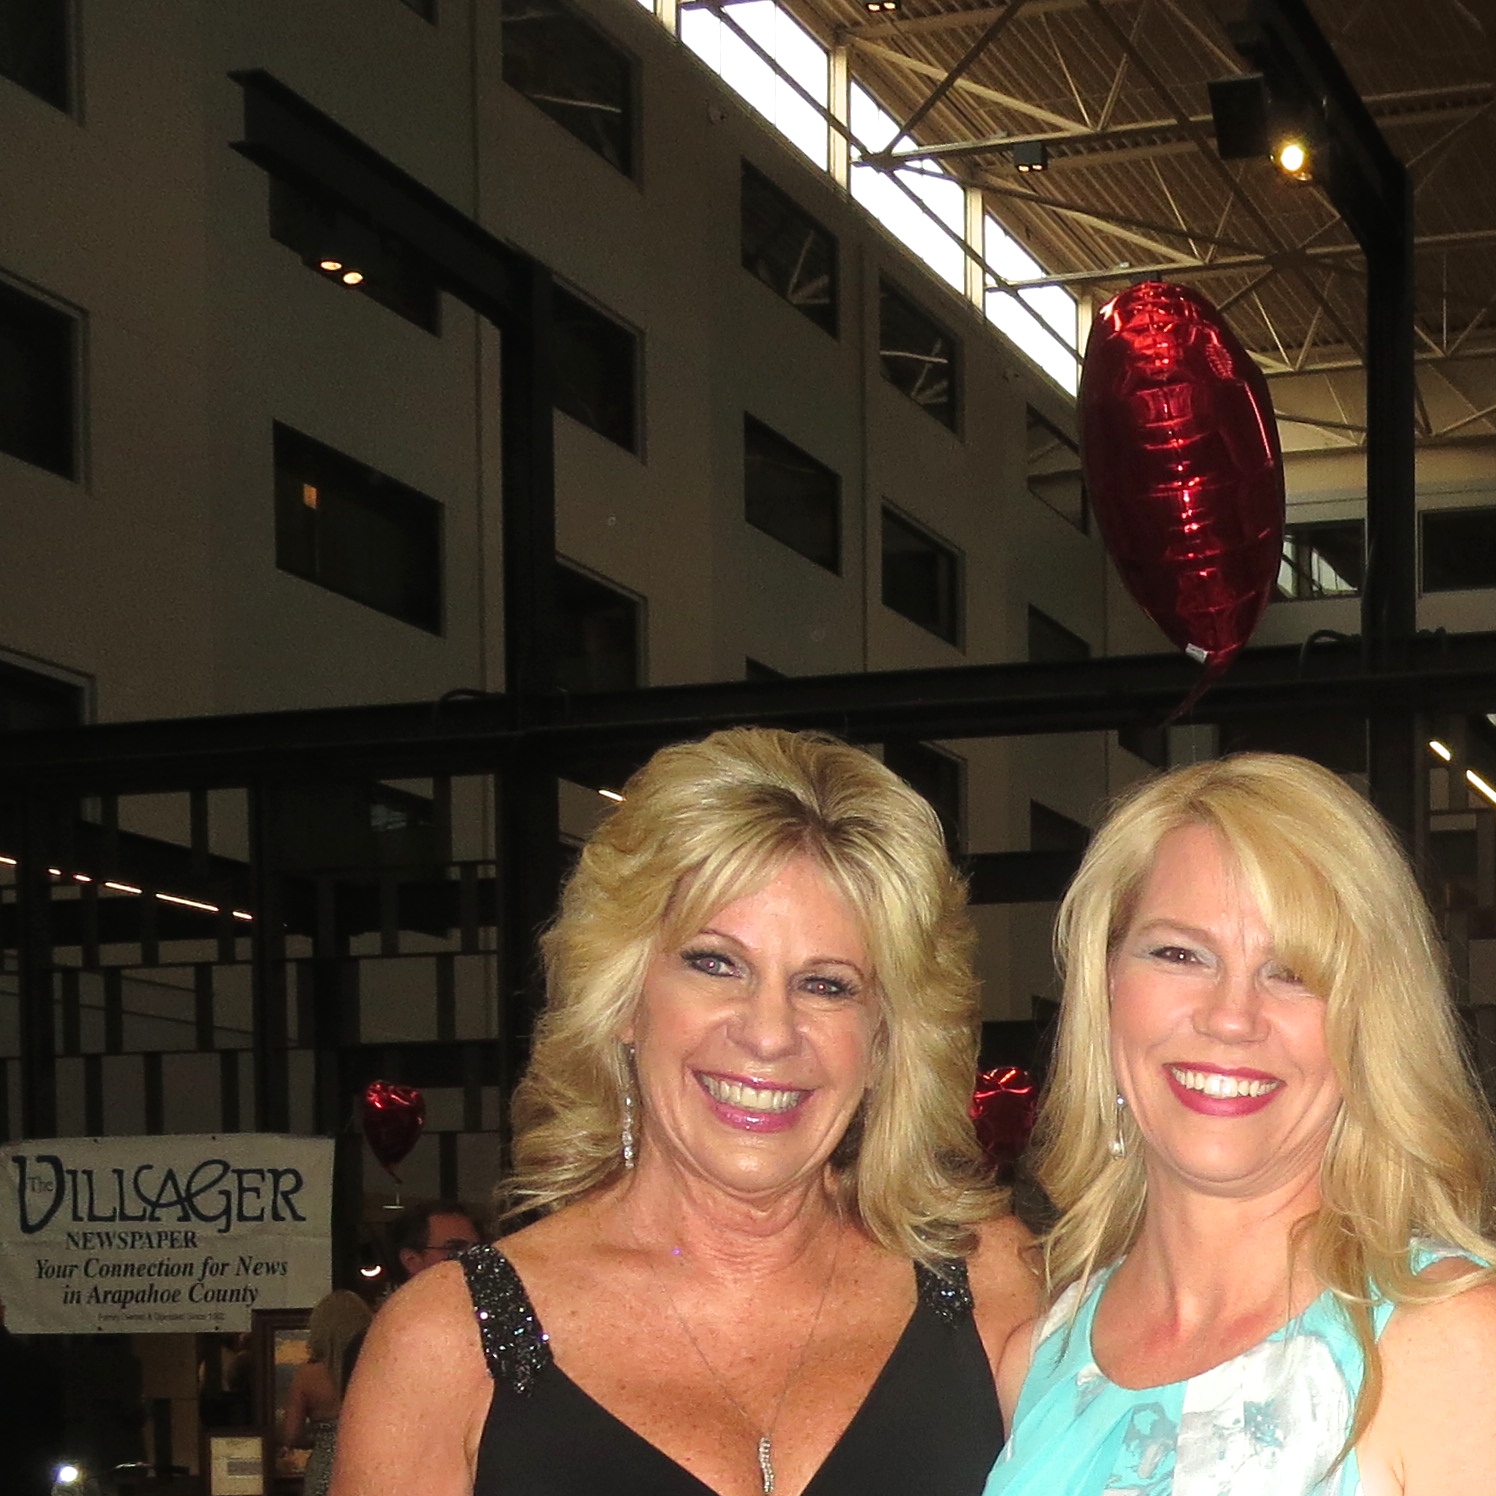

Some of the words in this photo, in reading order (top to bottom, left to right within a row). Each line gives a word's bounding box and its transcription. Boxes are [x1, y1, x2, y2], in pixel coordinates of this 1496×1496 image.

[11, 1154, 307, 1234] VILLAGER
[27, 1176, 54, 1193] The
[66, 1230, 199, 1251] NEWSPAPER
[35, 1258, 79, 1280] Your
[83, 1257, 195, 1279] Connection
[198, 1256, 229, 1282] for
[235, 1255, 289, 1277] News
[62, 1284, 82, 1305] in
[87, 1282, 182, 1310] Arapahoe
[188, 1282, 260, 1308] County
